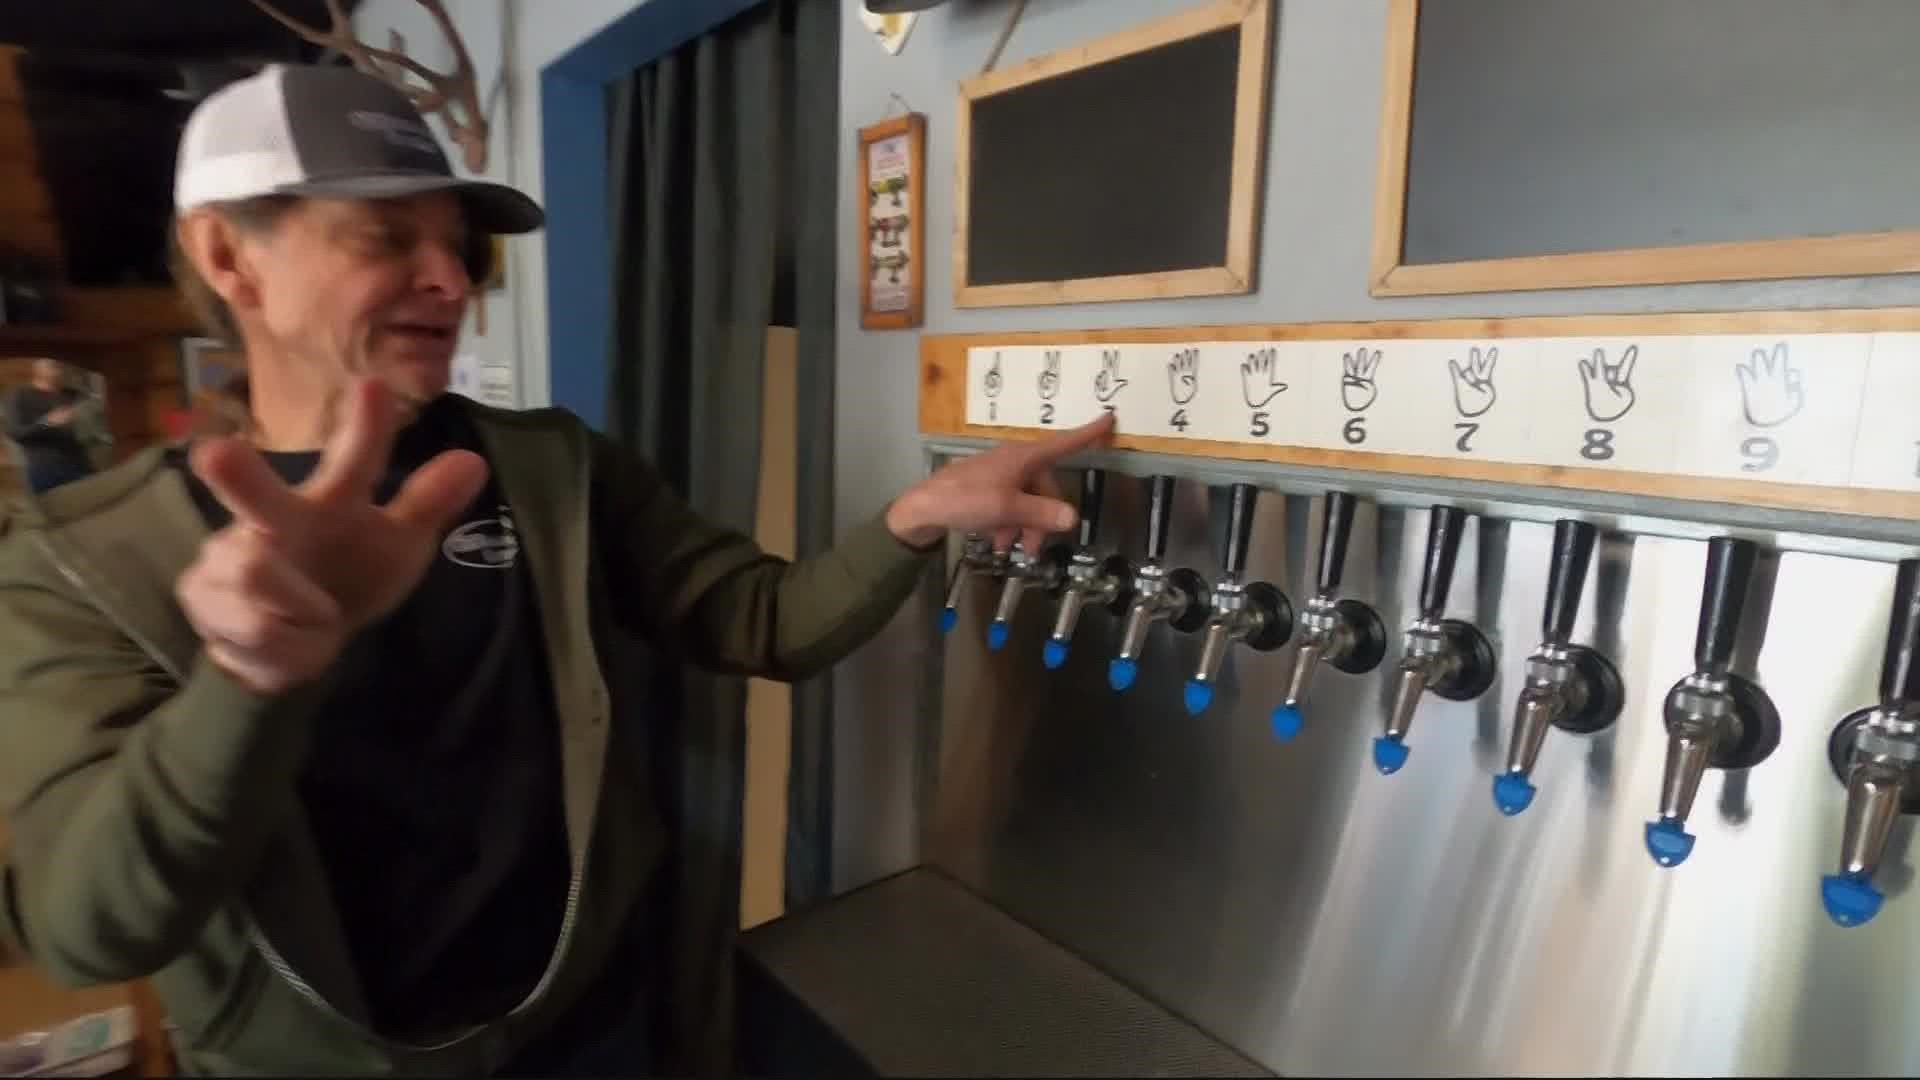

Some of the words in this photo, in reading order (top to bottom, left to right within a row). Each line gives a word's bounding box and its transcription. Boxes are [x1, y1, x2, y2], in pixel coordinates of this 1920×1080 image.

[1040, 403, 1055, 424] 2
[1170, 409, 1189, 432] 4
[1250, 412, 1270, 437] 5
[1342, 417, 1367, 444] 6
[1454, 422, 1480, 452] 7
[1580, 428, 1615, 461] 8
[1740, 436, 1780, 473] 9
